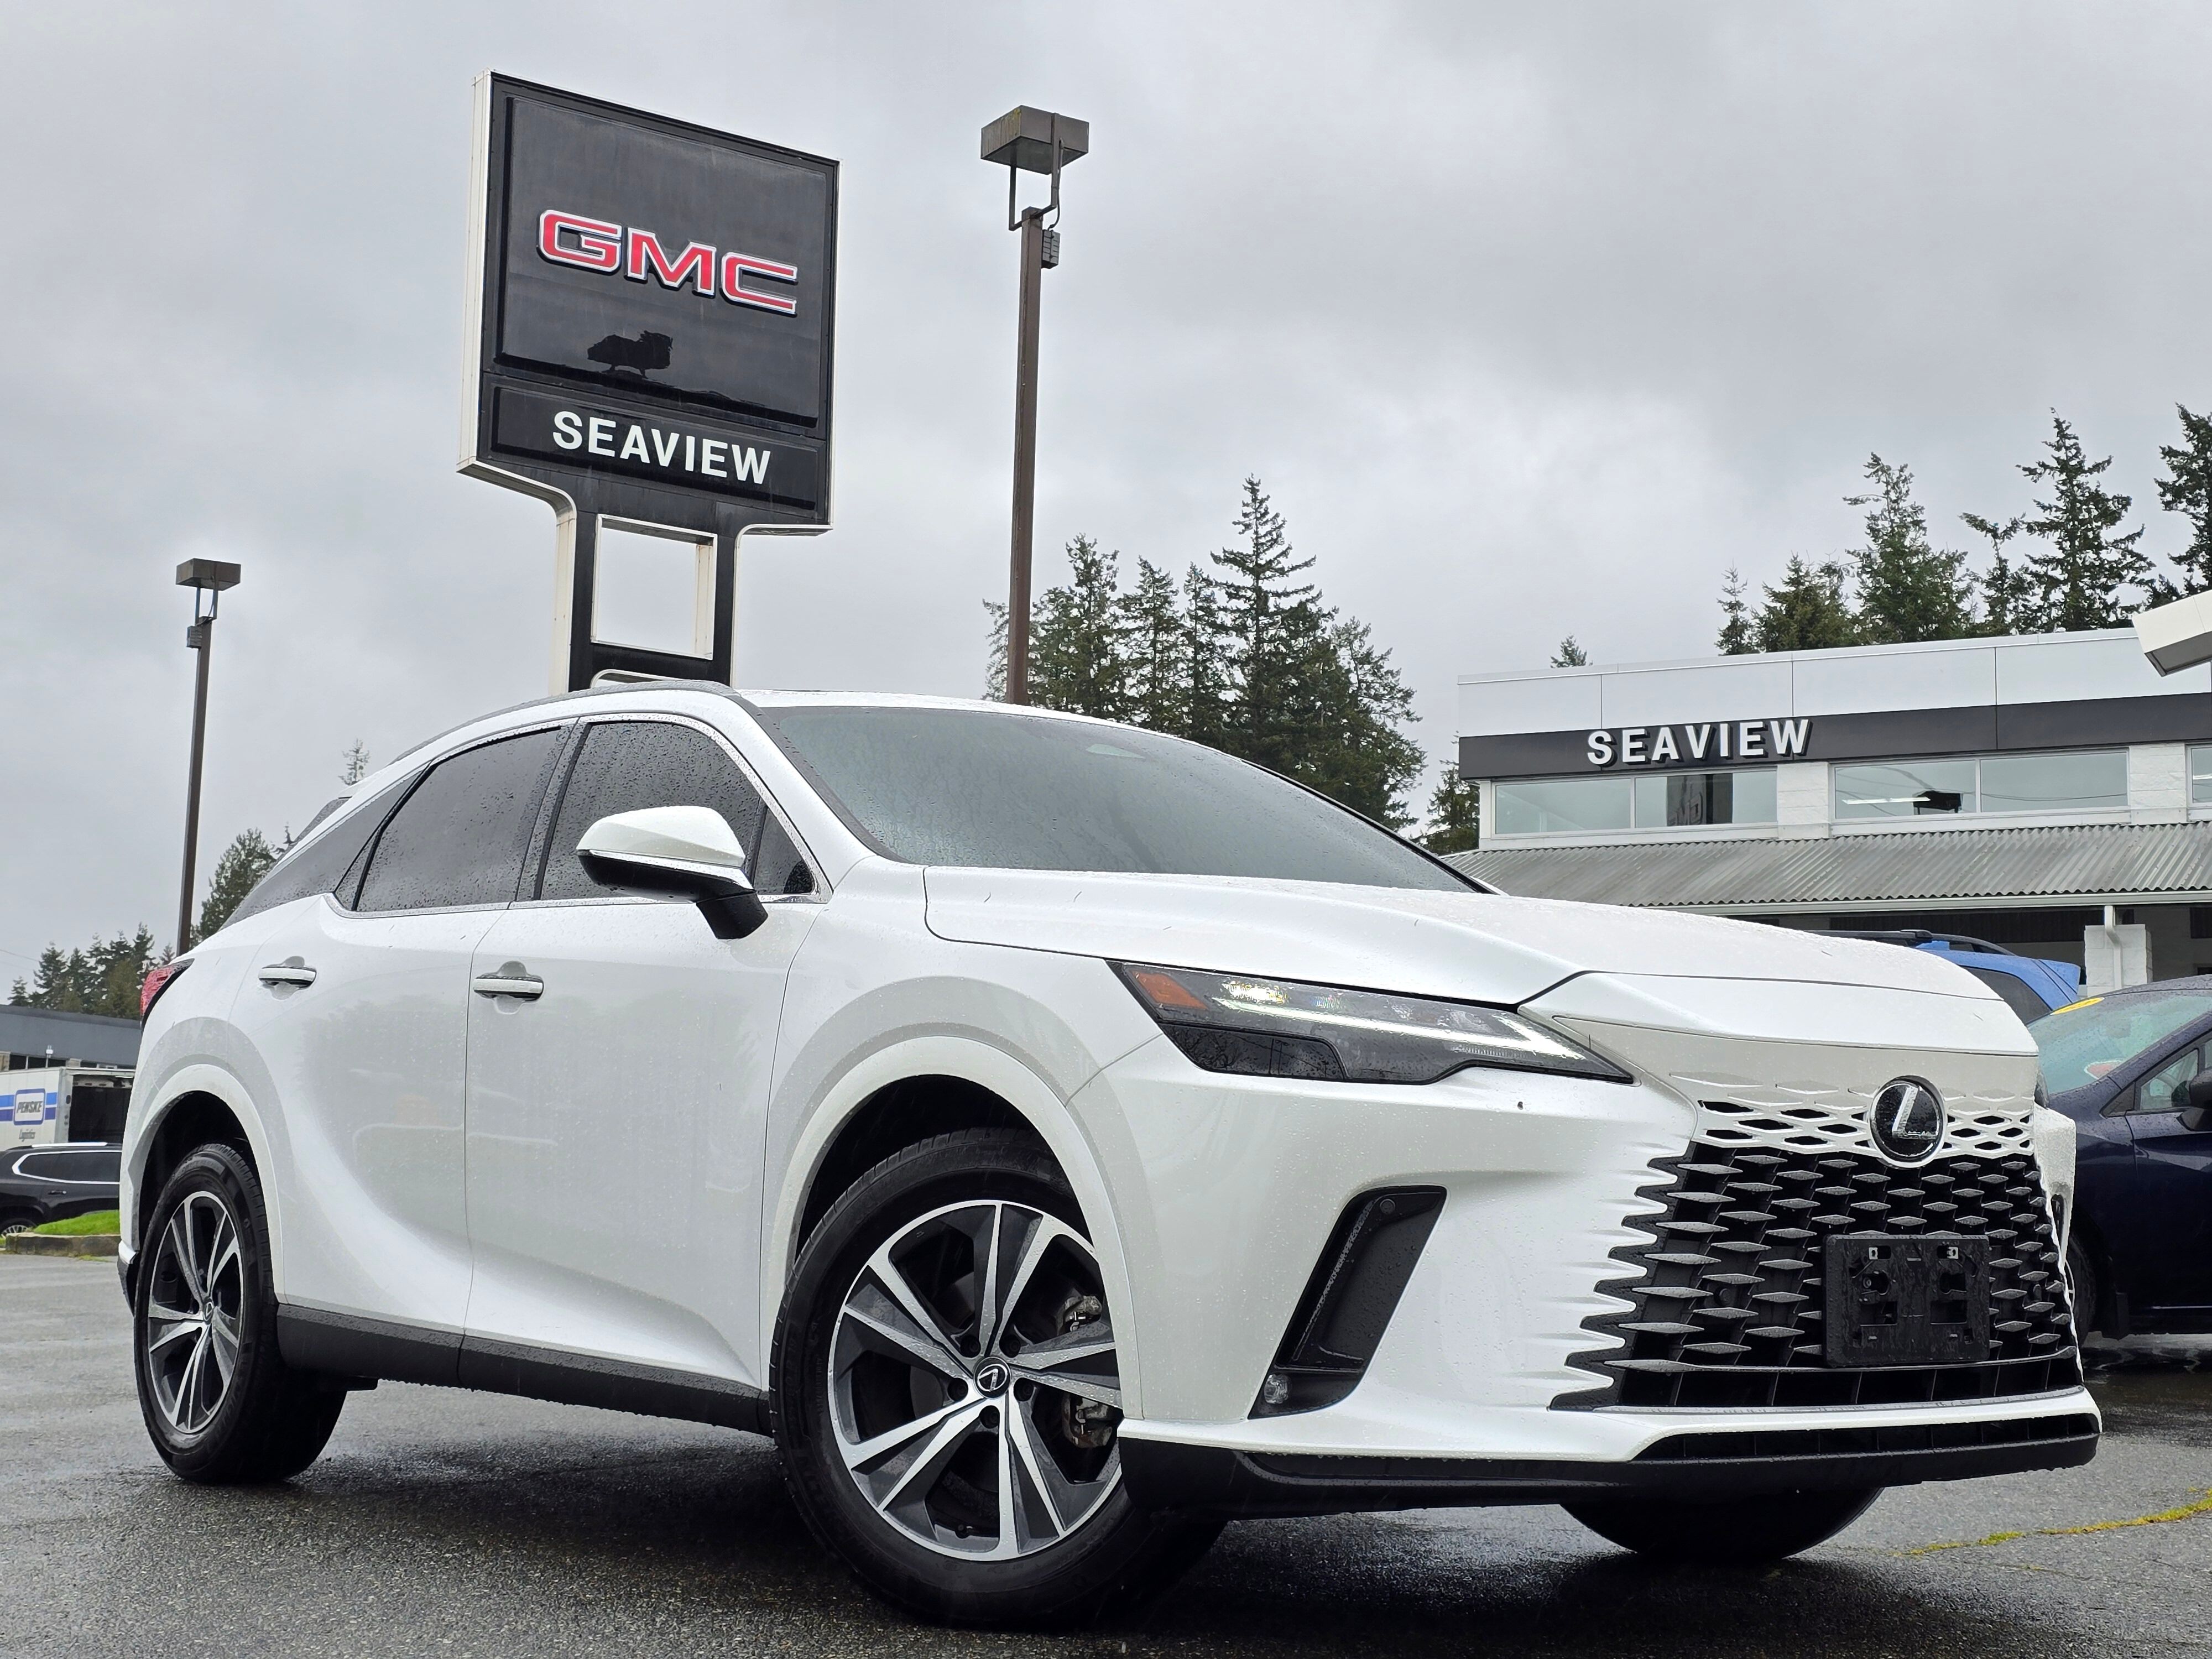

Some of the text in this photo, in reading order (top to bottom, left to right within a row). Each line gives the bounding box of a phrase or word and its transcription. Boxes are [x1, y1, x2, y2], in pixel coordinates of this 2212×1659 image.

[539, 210, 797, 314] GMC
[553, 411, 771, 484] SEAVIEW
[1587, 719, 1809, 765] SEAVIEW
[17, 1101, 43, 1113] PENSKE
